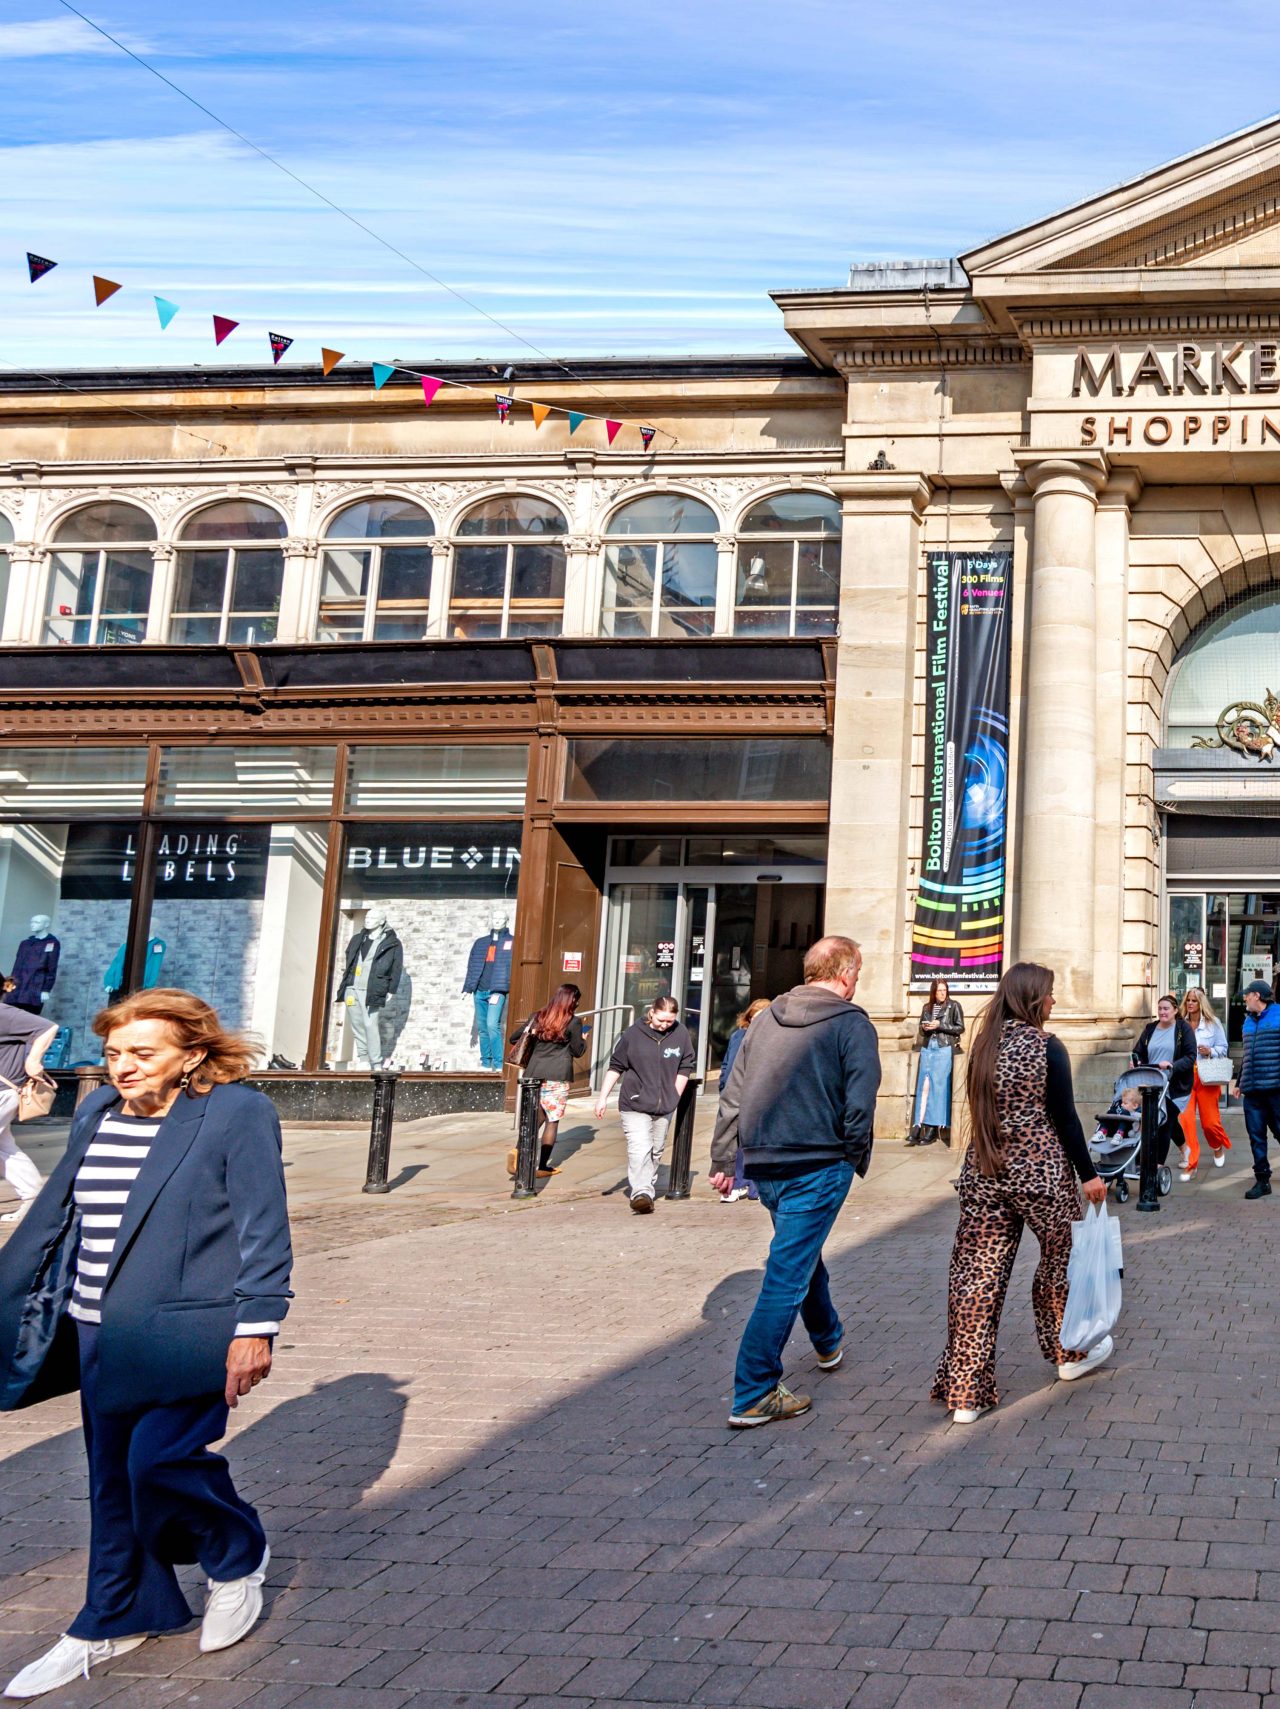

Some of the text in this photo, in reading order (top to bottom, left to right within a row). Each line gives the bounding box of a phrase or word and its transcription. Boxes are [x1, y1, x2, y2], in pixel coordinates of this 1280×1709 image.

[961, 574, 1004, 584] 300 Films
[971, 589, 1004, 597] Venues
[925, 560, 949, 872] Bolton International Film Festival
[126, 834, 239, 856] LADING
[347, 846, 522, 869] BLUE IN
[122, 860, 237, 882] LBELS
